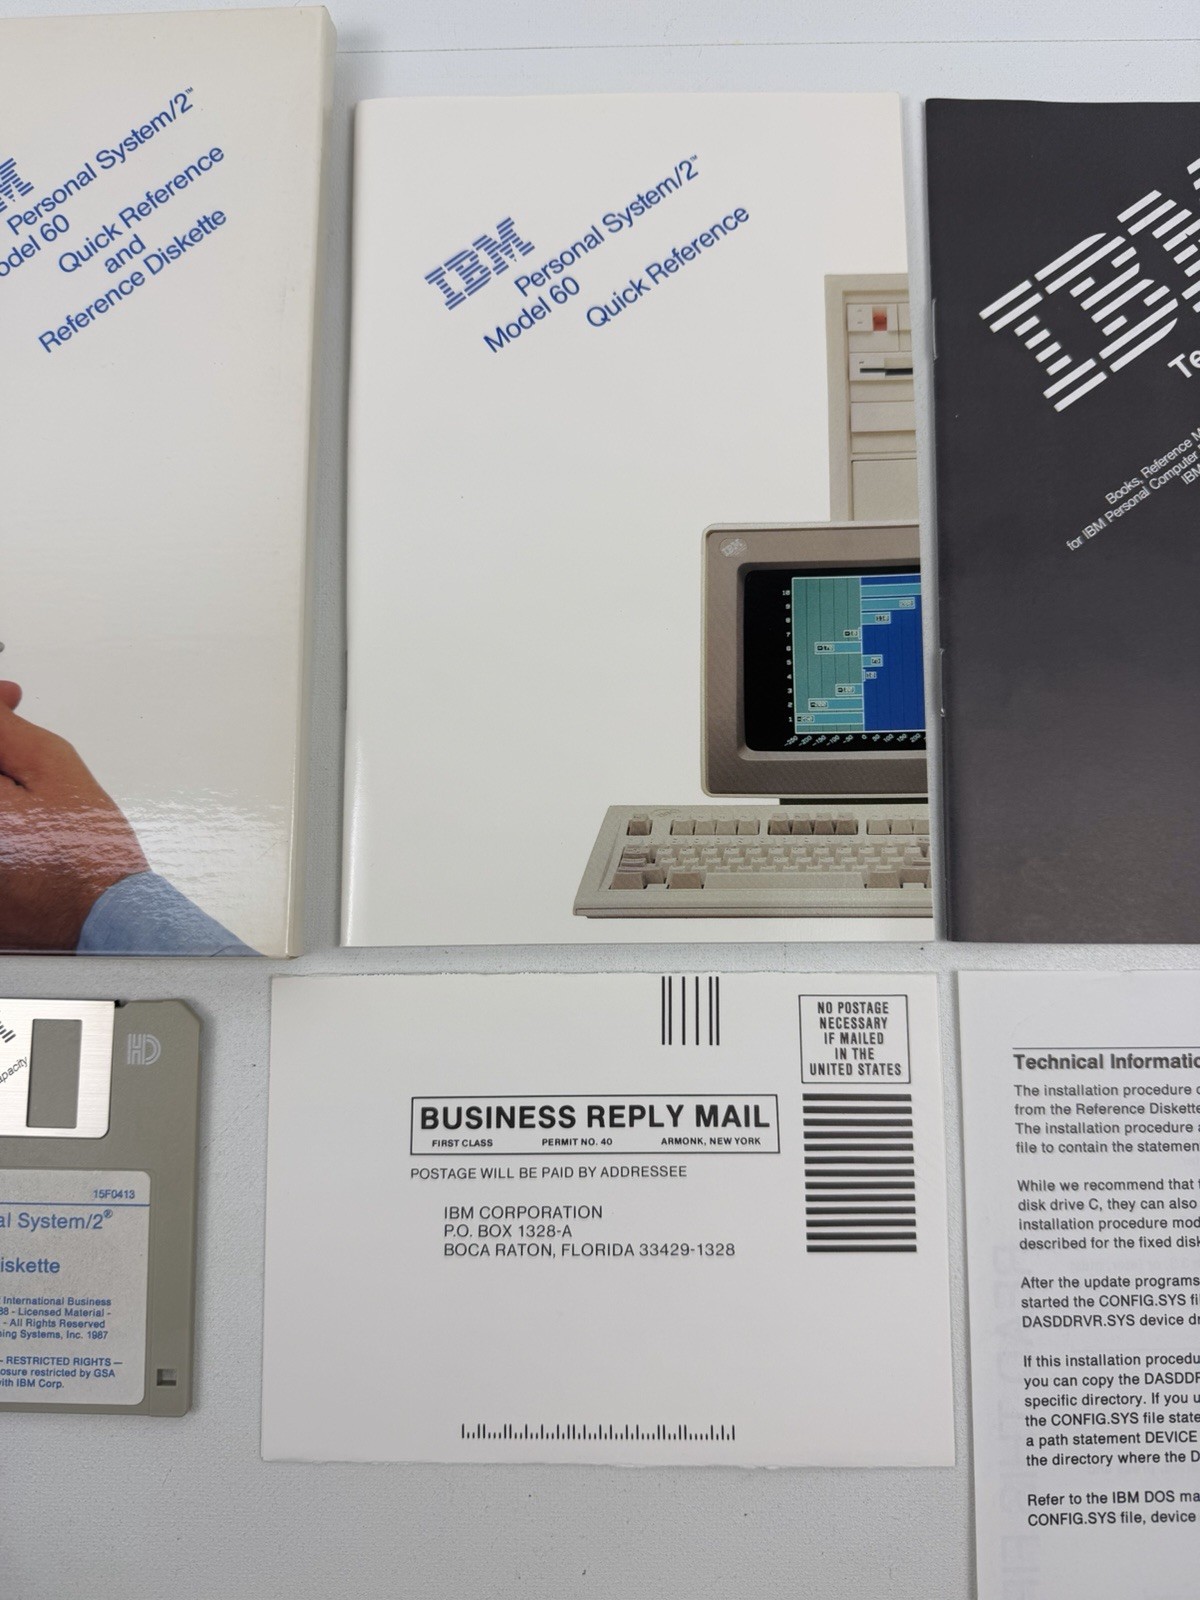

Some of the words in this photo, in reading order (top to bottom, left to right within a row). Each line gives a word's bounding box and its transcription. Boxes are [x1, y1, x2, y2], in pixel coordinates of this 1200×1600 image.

[6, 162, 98, 236] Personal
[58, 223, 124, 273] Quick
[118, 147, 224, 229] Reference
[40, 214, 70, 242] 60
[104, 233, 146, 274] and
[514, 225, 605, 297] Personal
[424, 216, 536, 311] IBM
[586, 278, 652, 327] Quick
[644, 208, 750, 285] Reference
[38, 271, 146, 353] Reference
[142, 210, 227, 275] Diskette
[483, 296, 552, 353] Model
[549, 276, 580, 304] 60
[1104, 477, 1144, 505] Books,
[1140, 439, 1193, 483] Reference
[1066, 536, 1083, 551] for
[1082, 517, 1107, 539] IBM
[1104, 481, 1151, 523] Personal
[1148, 451, 1199, 490] Computer
[720, 539, 747, 557] IBM
[817, 1001, 833, 1014] NO
[837, 1001, 889, 1014] POSTAGE
[819, 1016, 888, 1030] NECESSARY
[824, 1032, 835, 1045] IF
[840, 1032, 884, 1045] MAILED
[126, 1033, 162, 1065] HD
[834, 1047, 847, 1060] IN
[851, 1047, 875, 1060] THE
[1012, 1053, 1104, 1070] Technical
[809, 1063, 853, 1076] UNITED
[858, 1063, 902, 1076] STATES
[1013, 1084, 1040, 1097] The
[1044, 1084, 1119, 1097] installation
[1123, 1083, 1192, 1098] procedure
[420, 1105, 576, 1130] BUSINESS
[587, 1104, 684, 1128] REPLY
[695, 1104, 770, 1128] MAIL
[1014, 1103, 1046, 1116] from
[1050, 1103, 1072, 1115] the
[1076, 1103, 1146, 1115] Reference
[1014, 1122, 1042, 1135] The
[1045, 1122, 1120, 1134] installation
[1124, 1121, 1194, 1136] procedure
[432, 1139, 460, 1148] FIRST
[461, 1138, 494, 1148] CLASS
[542, 1138, 578, 1146] PERMIT
[580, 1137, 598, 1146] NO.
[600, 1137, 613, 1146] 40
[660, 1137, 707, 1146] ARMONK,
[709, 1137, 732, 1145] NEW
[734, 1137, 761, 1145] YORK
[1015, 1141, 1038, 1154] file
[1040, 1142, 1054, 1154] to
[1058, 1140, 1108, 1153] contain
[1111, 1140, 1134, 1153] the
[410, 1167, 476, 1180] POSTAGE
[480, 1167, 515, 1179] WILL
[519, 1167, 538, 1179] BE
[542, 1166, 574, 1178] PAID
[578, 1166, 597, 1178] BY
[600, 1165, 687, 1178] ADDRESSEE
[1016, 1179, 1056, 1192] While
[1059, 1181, 1080, 1192] we
[1084, 1178, 1164, 1191] recommend
[1168, 1178, 1194, 1190] that
[93, 1189, 136, 1200] 15F0413
[444, 1206, 474, 1220] IBM
[479, 1205, 602, 1220] CORPORATION
[1018, 1199, 1046, 1212] disk
[1050, 1198, 1085, 1211] drive
[1088, 1198, 1103, 1212] C,
[1106, 1198, 1136, 1213] they
[1140, 1200, 1165, 1210] can
[1168, 1197, 1198, 1210] also
[444, 1223, 473, 1238] P.O.
[478, 1224, 512, 1238] BOX
[518, 1224, 572, 1238] 1328-A
[1018, 1217, 1094, 1231] installation
[1098, 1217, 1168, 1232] procedure
[444, 1242, 491, 1257] BOCA
[495, 1243, 556, 1259] RATON,
[561, 1242, 635, 1257] FLORIDA
[639, 1243, 736, 1257] 33429-1328
[1019, 1237, 1087, 1250] described
[1090, 1236, 1110, 1249] for
[1113, 1236, 1135, 1249] the
[1138, 1236, 1172, 1248] fixed
[0, 1256, 61, 1274] iskette
[1020, 1276, 1054, 1289] After
[1058, 1276, 1080, 1289] the
[1084, 1275, 1131, 1291] update
[2, 1296, 65, 1306] International
[67, 1296, 112, 1307] Business
[1021, 1295, 1070, 1309] started
[1073, 1295, 1095, 1308] the
[1098, 1293, 1186, 1308] CONFIG.SYS
[18, 1307, 62, 1317] Licensed
[64, 1307, 105, 1318] Material
[9, 1318, 23, 1327] All
[25, 1318, 57, 1330] Rights
[58, 1318, 106, 1329] Reserved
[1022, 1314, 1136, 1328] DASDDRVR.SYS
[1139, 1313, 1184, 1326] device
[20, 1329, 64, 1340] Systems,
[66, 1330, 84, 1340] Inc.
[87, 1330, 109, 1340] 1987
[6, 1355, 70, 1366] RESTRICTED
[72, 1357, 112, 1367] RIGHTS
[1023, 1355, 1032, 1368] If
[1035, 1354, 1062, 1368] this
[1065, 1353, 1141, 1367] installation
[30, 1368, 77, 1378] restricted
[79, 1368, 92, 1380] by
[93, 1368, 116, 1378] GSA
[1023, 1377, 1049, 1390] you
[1053, 1377, 1078, 1387] can
[1082, 1376, 1114, 1389] copy
[1118, 1373, 1140, 1386] the
[16, 1378, 36, 1388] IBM
[38, 1378, 64, 1390] Corp.
[1024, 1394, 1078, 1410] specific
[1081, 1393, 1147, 1408] directory.
[1151, 1392, 1160, 1404] If
[1163, 1394, 1188, 1407] you
[1024, 1414, 1047, 1427] the
[1050, 1411, 1139, 1427] CONFIG.SYS
[1142, 1412, 1165, 1424] file
[1026, 1437, 1035, 1447] a
[1038, 1433, 1068, 1449] path
[1072, 1432, 1141, 1446] statement
[1145, 1430, 1198, 1444] DEVICE
[1026, 1454, 1048, 1467] the
[1052, 1453, 1114, 1467] directory
[1117, 1451, 1161, 1464] where
[1164, 1450, 1186, 1463] the
[1027, 1493, 1066, 1506] Refer
[1068, 1493, 1082, 1505] to
[1086, 1492, 1108, 1504] the
[1112, 1491, 1140, 1504] IBM
[1144, 1490, 1176, 1503] DOS
[1027, 1511, 1117, 1527] CONFIG.SYS
[1120, 1511, 1146, 1525] file,
[1150, 1510, 1196, 1523] device
